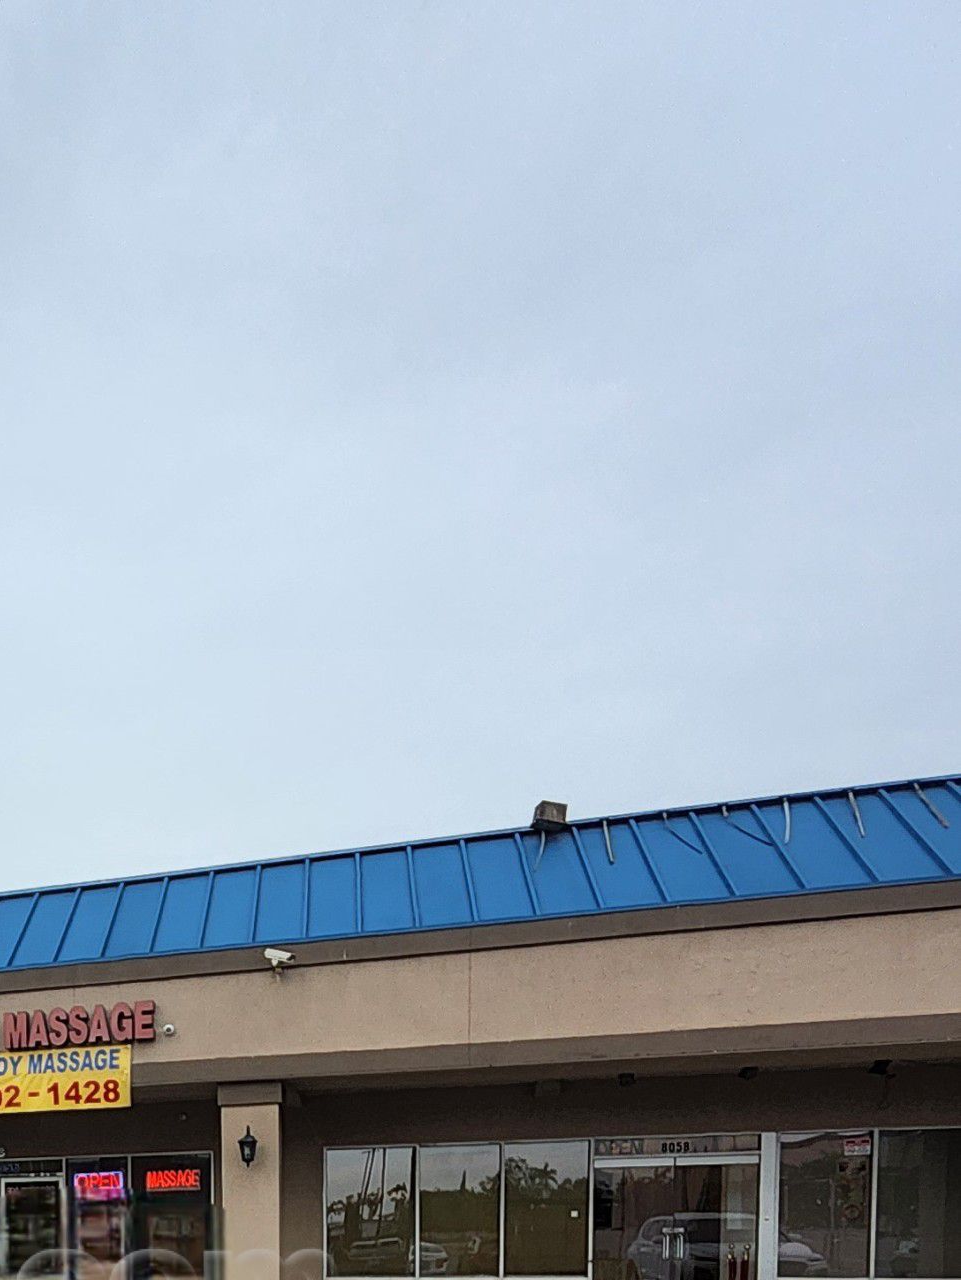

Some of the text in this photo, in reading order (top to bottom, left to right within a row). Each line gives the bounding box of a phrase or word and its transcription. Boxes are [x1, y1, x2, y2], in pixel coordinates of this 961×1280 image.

[3, 1000, 156, 1050] MASSAGE
[28, 1048, 121, 1074] MASSAGE
[76, 1172, 122, 1191] OPEN
[146, 1169, 200, 1189] MASSAGE
